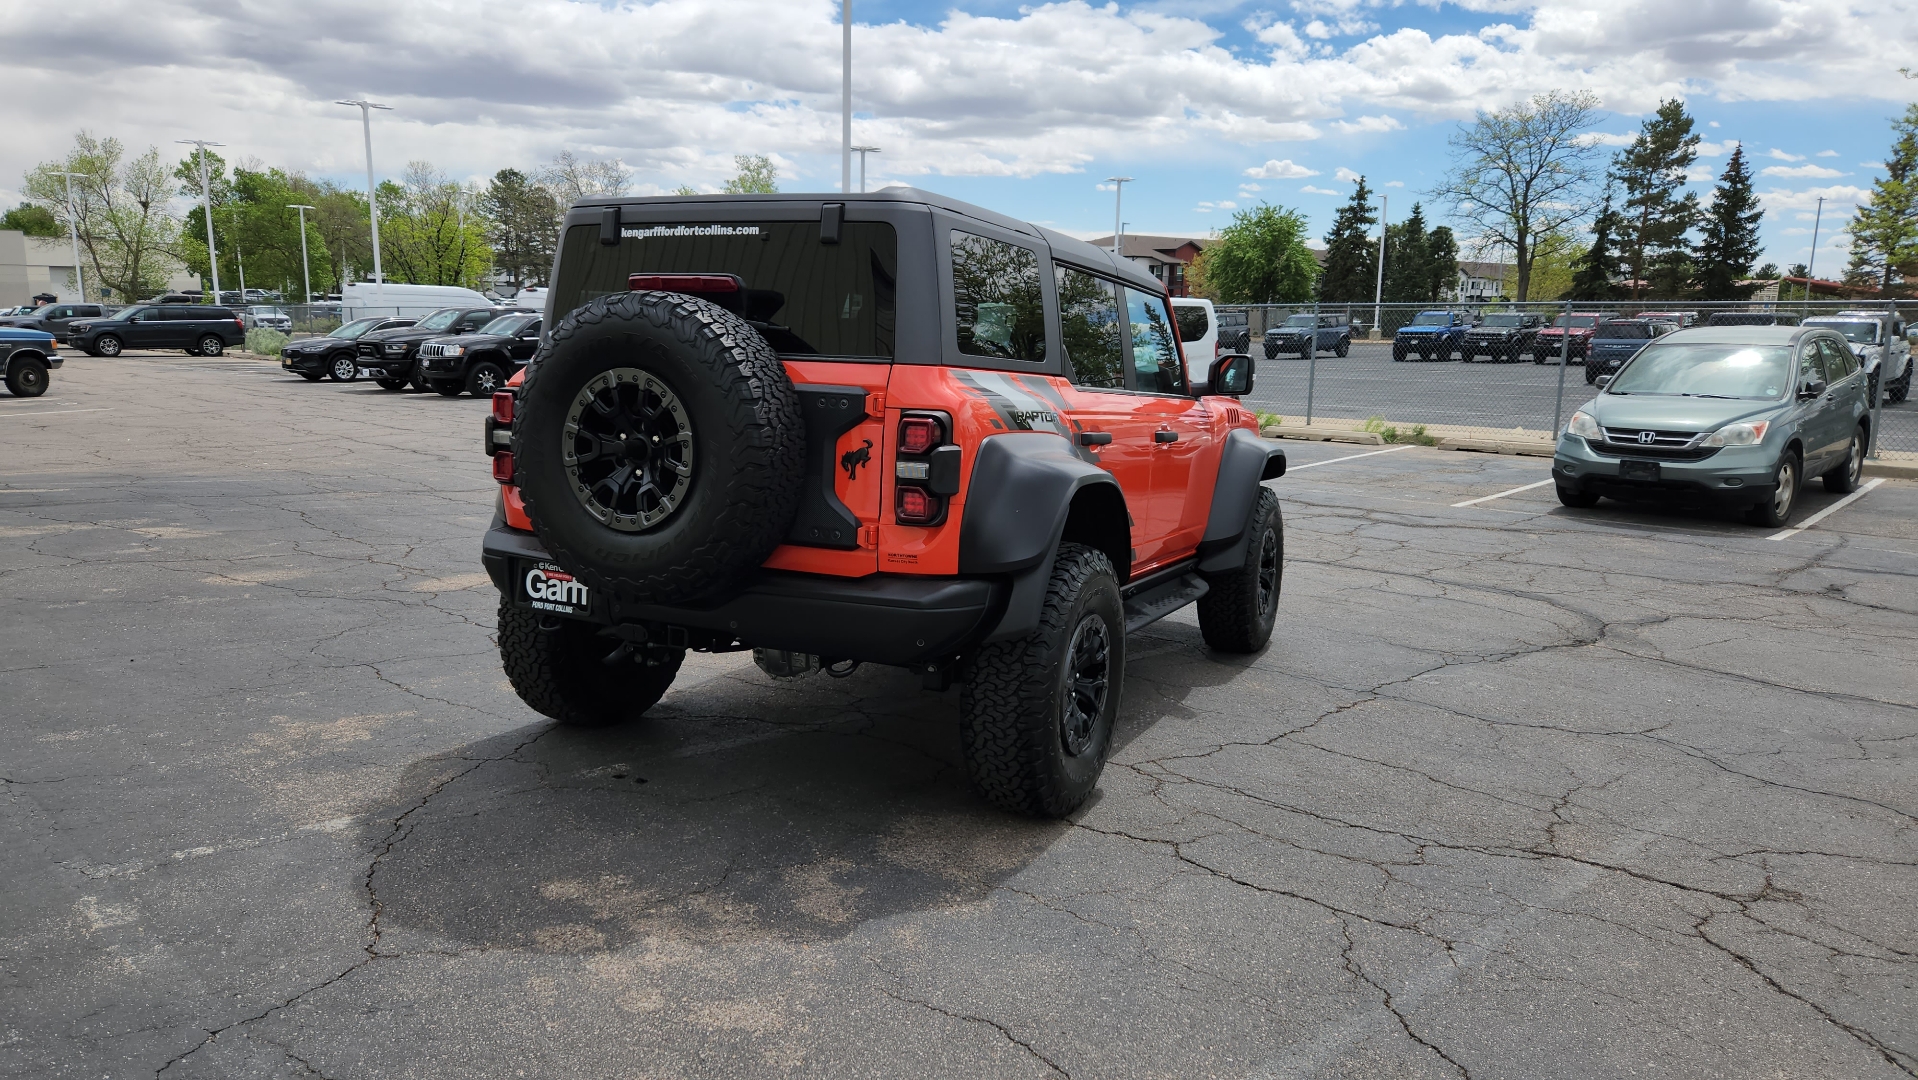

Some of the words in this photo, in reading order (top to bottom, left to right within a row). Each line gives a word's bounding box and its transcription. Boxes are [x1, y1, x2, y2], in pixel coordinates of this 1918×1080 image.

[621, 225, 759, 239] kengarfffordfortcollins.com
[1014, 410, 1062, 428] RAPTOR
[544, 562, 558, 572] Ken
[532, 601, 544, 609] FORD
[544, 602, 555, 611] FORT
[555, 604, 573, 613] COLLINS
